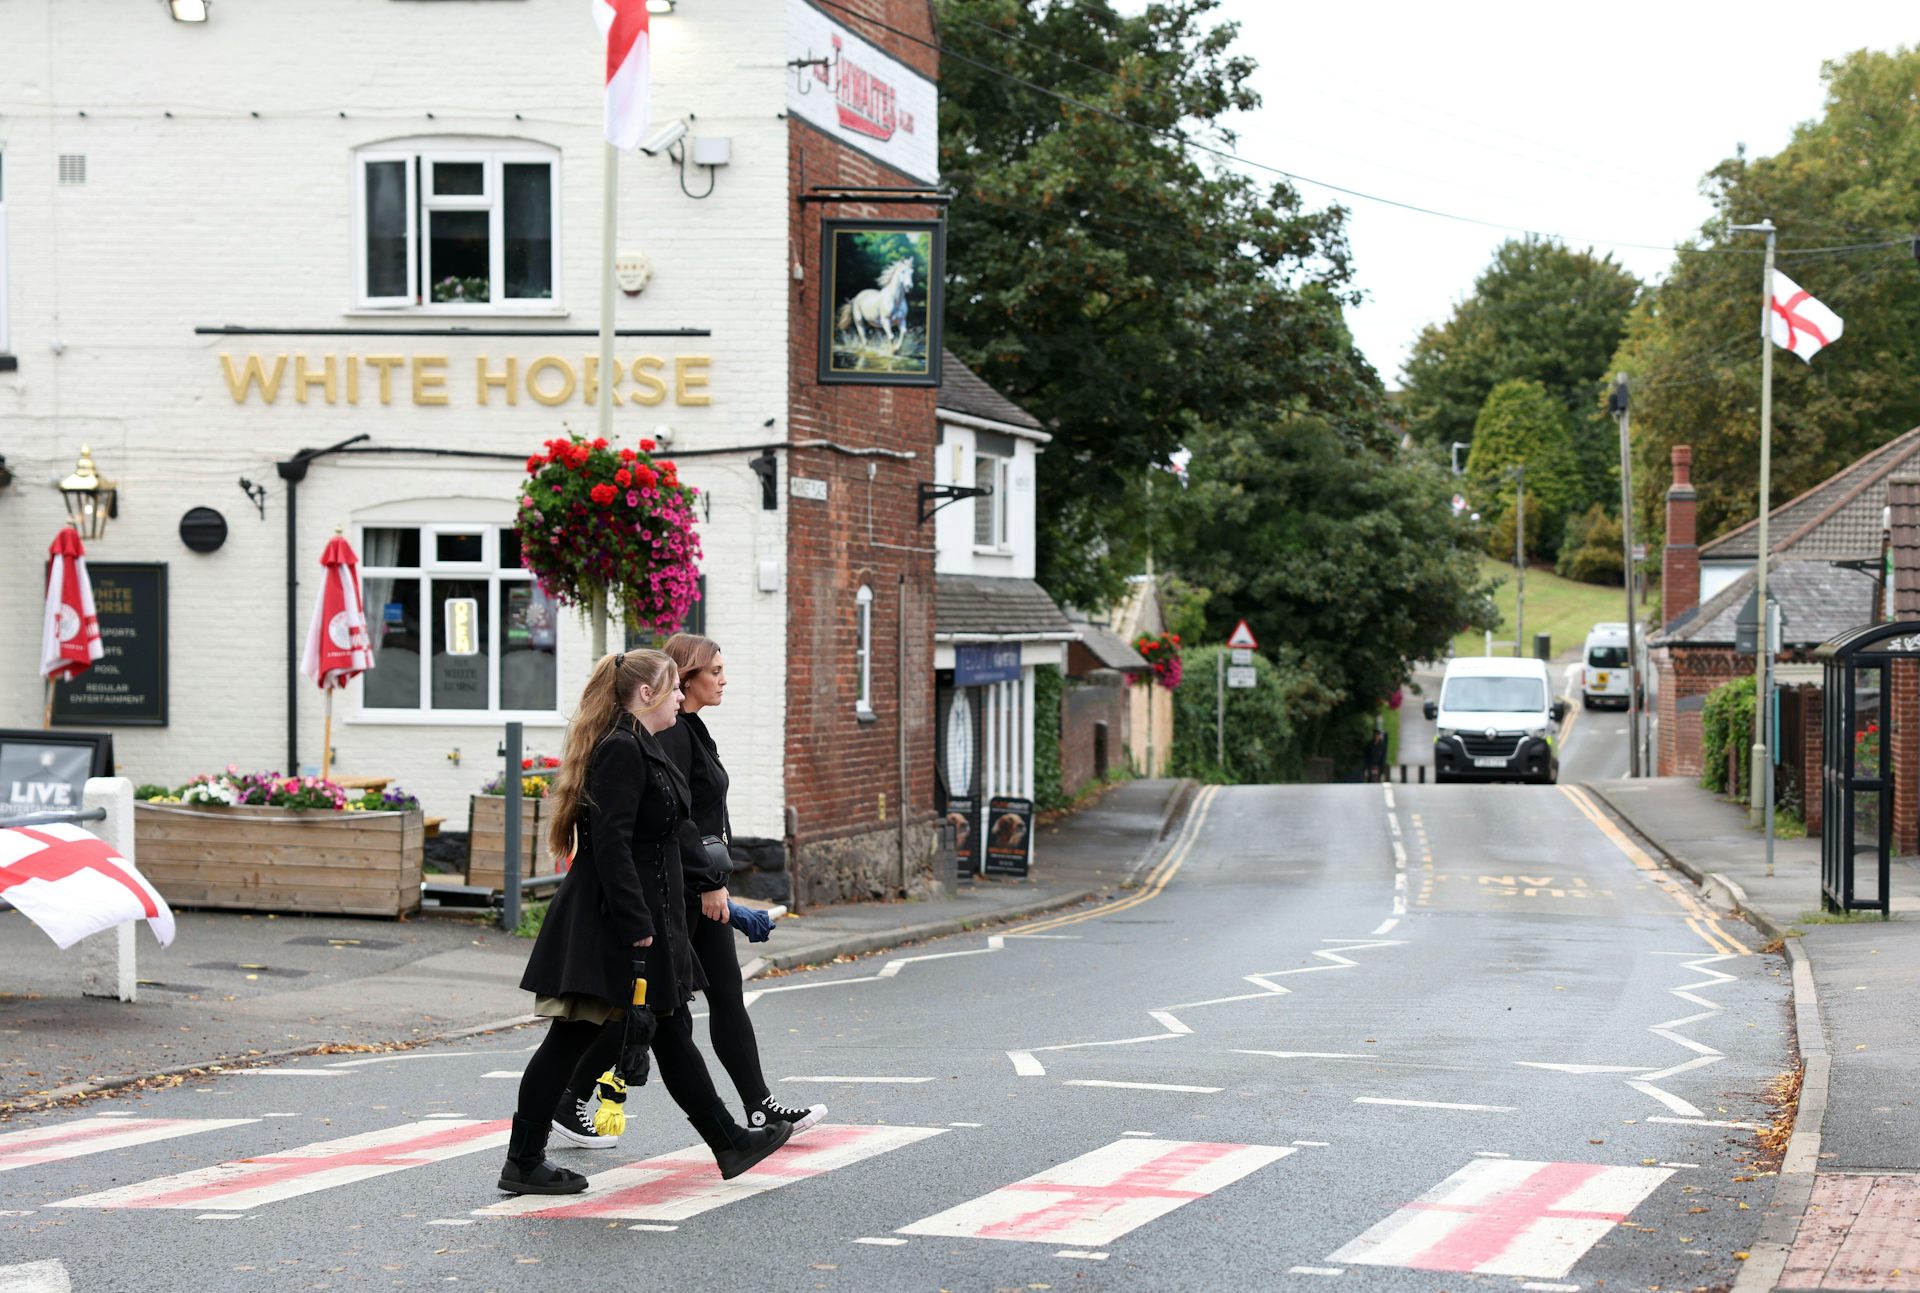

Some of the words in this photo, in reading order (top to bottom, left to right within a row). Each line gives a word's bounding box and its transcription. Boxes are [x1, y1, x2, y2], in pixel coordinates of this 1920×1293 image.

[219, 352, 450, 407] WHITE
[475, 353, 713, 408] HORSE
[94, 588, 132, 599] HITE
[96, 601, 133, 613] ORSE
[94, 664, 119, 674] POOL
[86, 683, 128, 692] REGULAR
[70, 694, 145, 703] ENTERTAINMENT
[10, 781, 72, 805] LIVE
